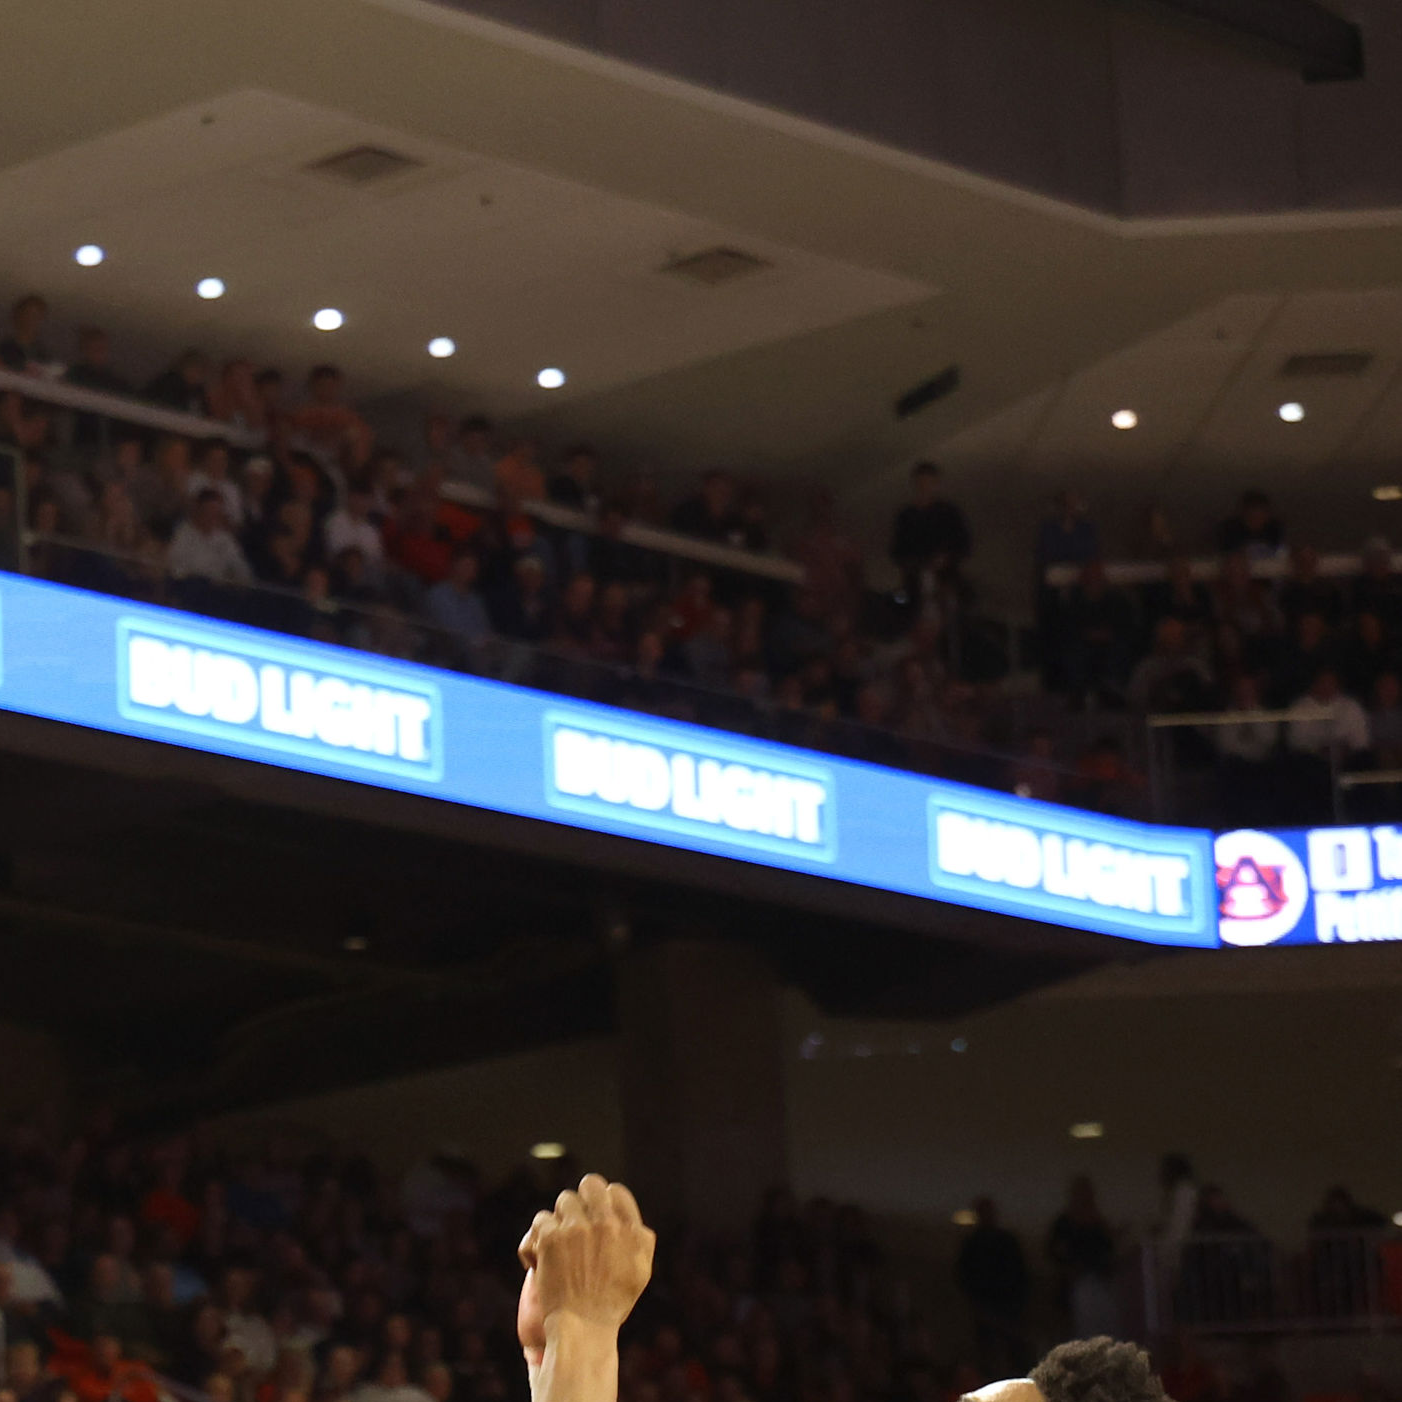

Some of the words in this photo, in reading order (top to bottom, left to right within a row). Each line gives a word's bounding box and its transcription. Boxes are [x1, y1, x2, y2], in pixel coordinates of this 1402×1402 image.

[129, 638, 259, 723] BUD
[260, 666, 430, 760] LIGHT
[553, 729, 669, 811] BUD
[670, 754, 826, 843] LIGHT
[936, 812, 1042, 888] BUD
[1042, 834, 1189, 916] LIGHT
